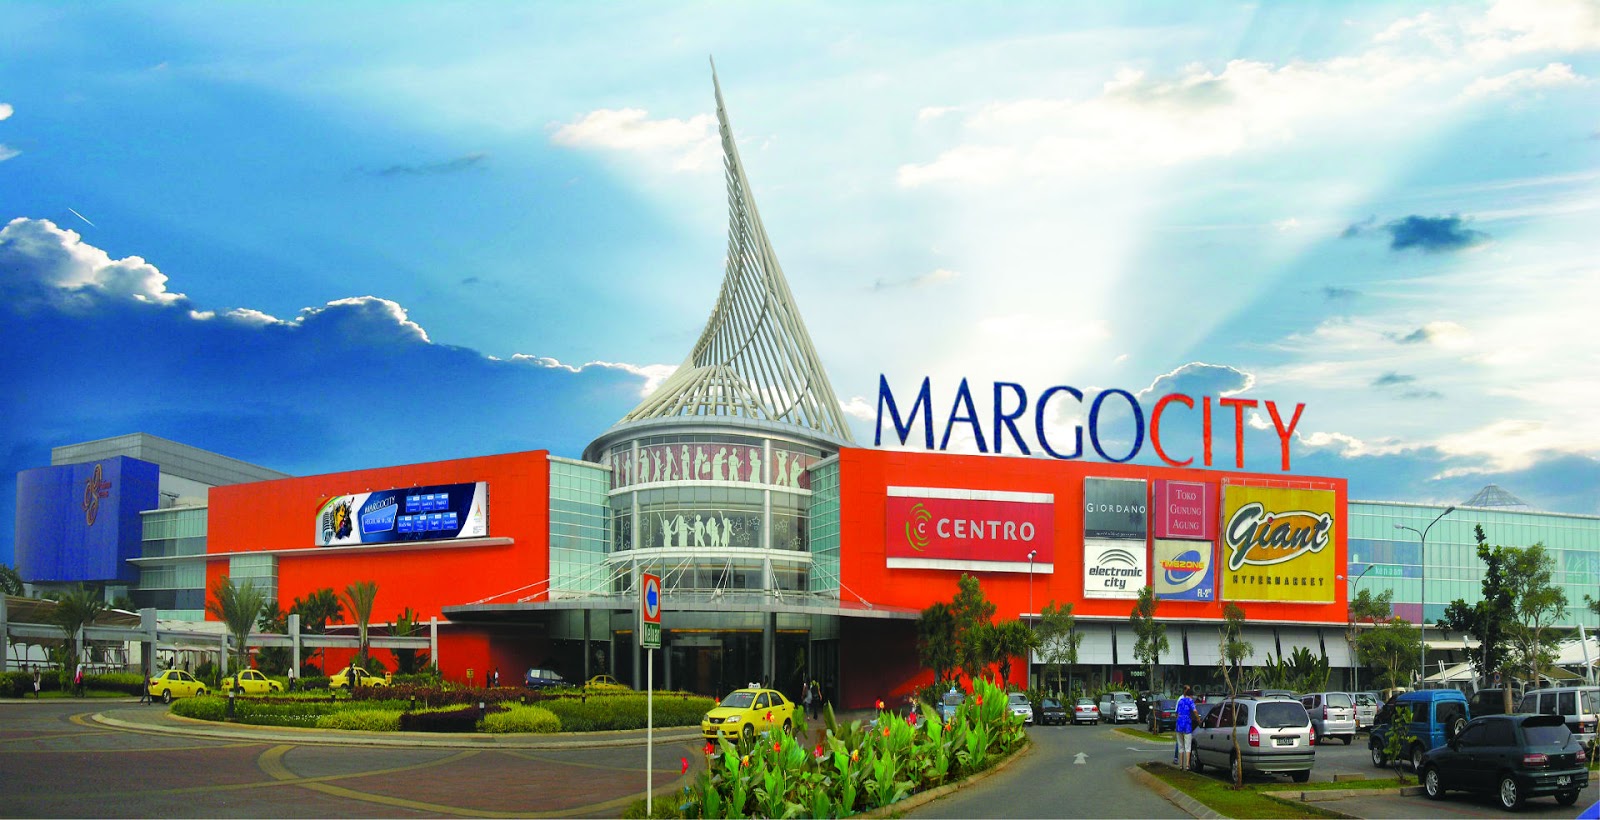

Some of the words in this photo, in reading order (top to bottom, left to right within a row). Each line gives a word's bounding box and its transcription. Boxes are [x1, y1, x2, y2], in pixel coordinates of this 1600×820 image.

[874, 373, 1306, 472] MARGOCITY
[1176, 489, 1197, 501] TOKO
[1086, 502, 1146, 514] GIORDANO
[1170, 504, 1202, 516] GUNUNG
[936, 517, 1035, 542] CENTRO
[1172, 519, 1200, 530] AGUNG
[1227, 504, 1331, 569] Giant
[1159, 560, 1205, 570] TIMEZONE
[1089, 566, 1143, 577] electronic
[1104, 577, 1126, 589] city
[1232, 575, 1324, 587] HYPERMARKET
[644, 624, 660, 642] Keluar
